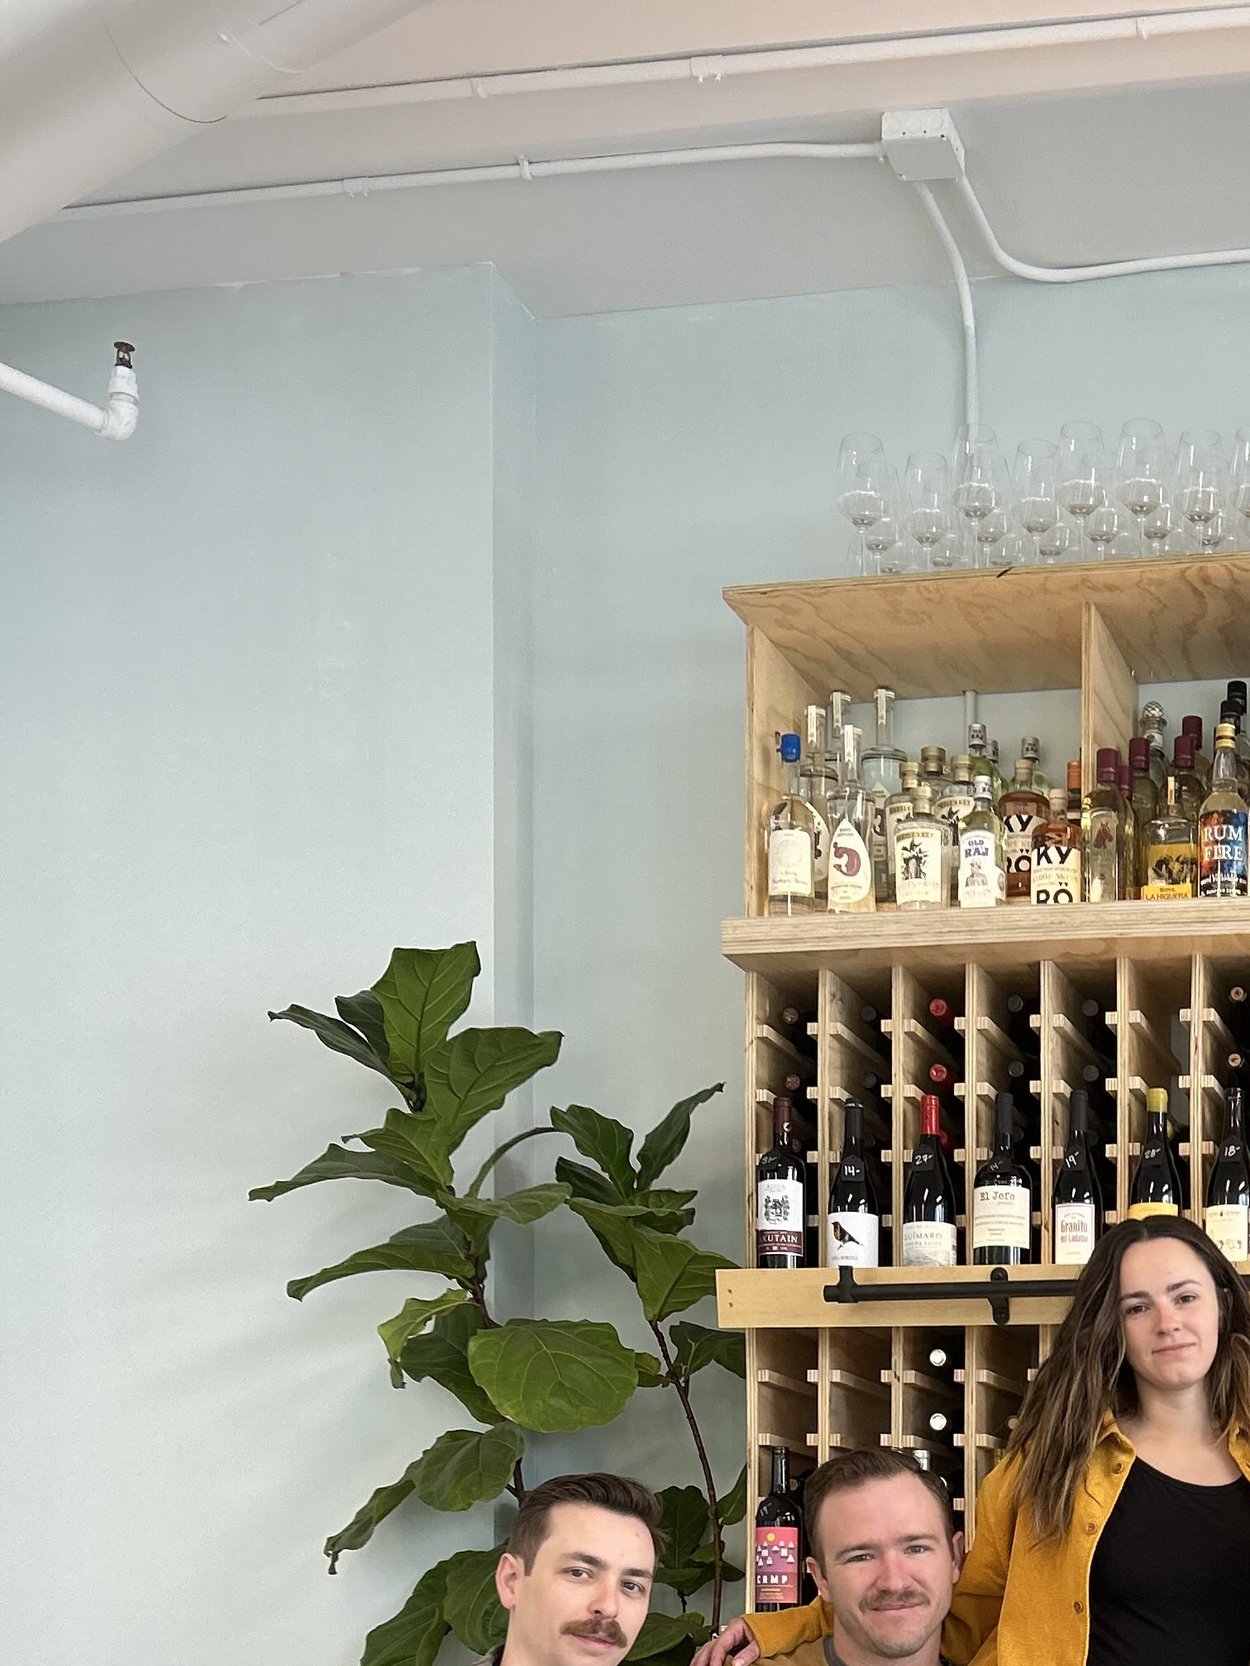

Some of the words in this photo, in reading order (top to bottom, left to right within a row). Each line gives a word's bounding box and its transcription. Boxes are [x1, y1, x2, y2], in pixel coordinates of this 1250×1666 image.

[1204, 824, 1244, 841] RUM
[967, 839, 984, 847] OLD
[964, 847, 989, 859] RAJ
[1036, 845, 1073, 867] KY
[1204, 844, 1244, 861] FIRE
[844, 1164, 861, 1177] 14-
[980, 1192, 990, 1201] El
